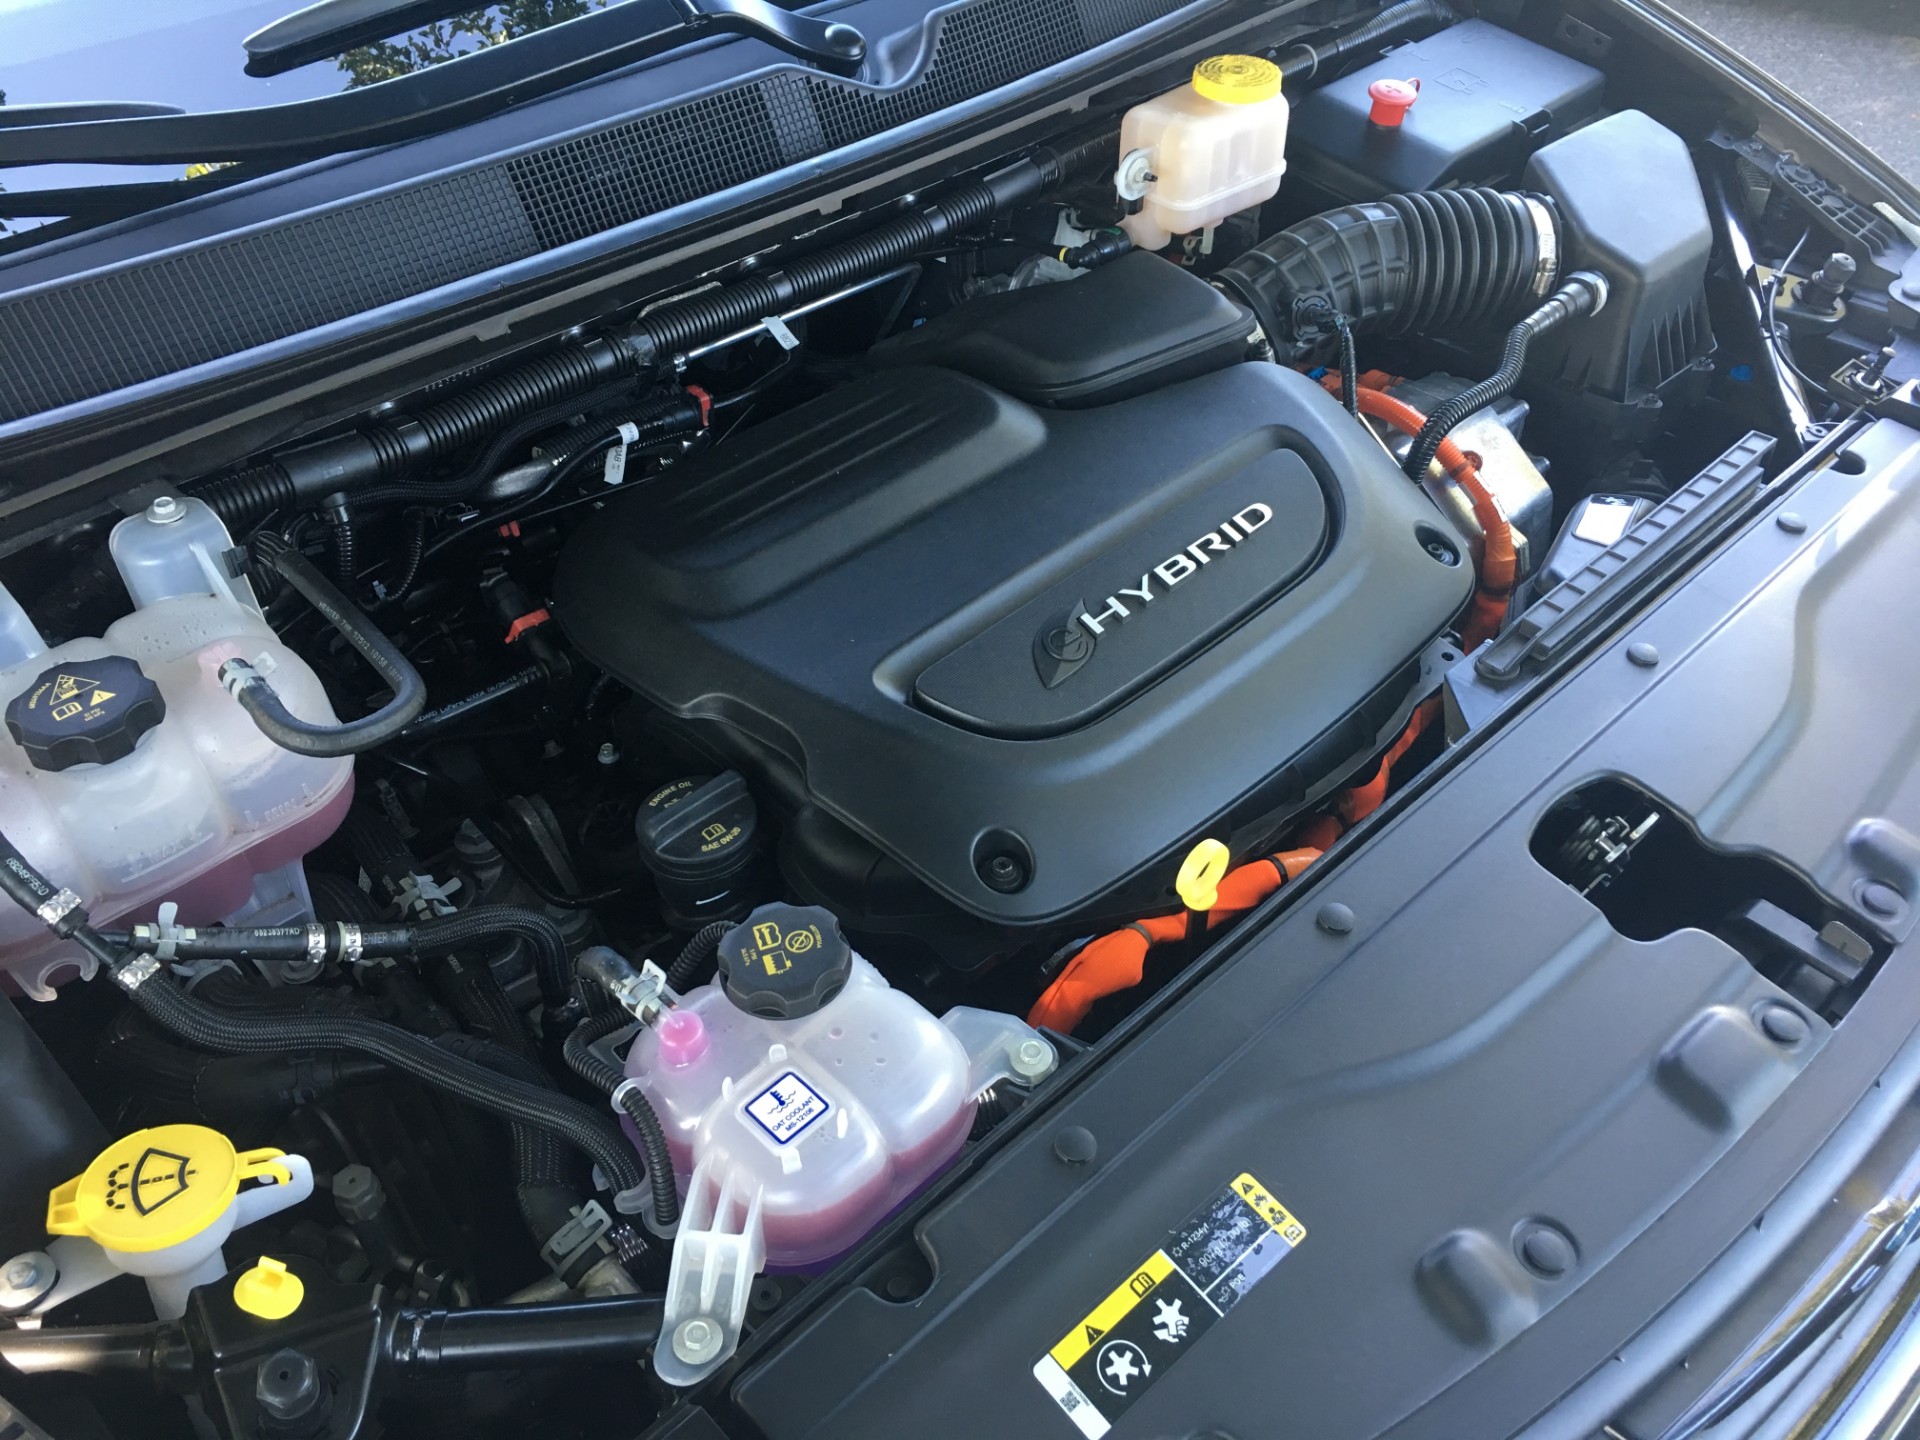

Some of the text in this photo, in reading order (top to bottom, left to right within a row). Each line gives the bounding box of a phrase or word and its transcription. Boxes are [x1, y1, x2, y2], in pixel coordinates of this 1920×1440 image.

[1080, 502, 1273, 635] HYBRID
[649, 785, 677, 807] ENGINE
[678, 781, 693, 789] OIL
[701, 842, 720, 852] SAE
[772, 1096, 815, 1132] OAT COOLANT
